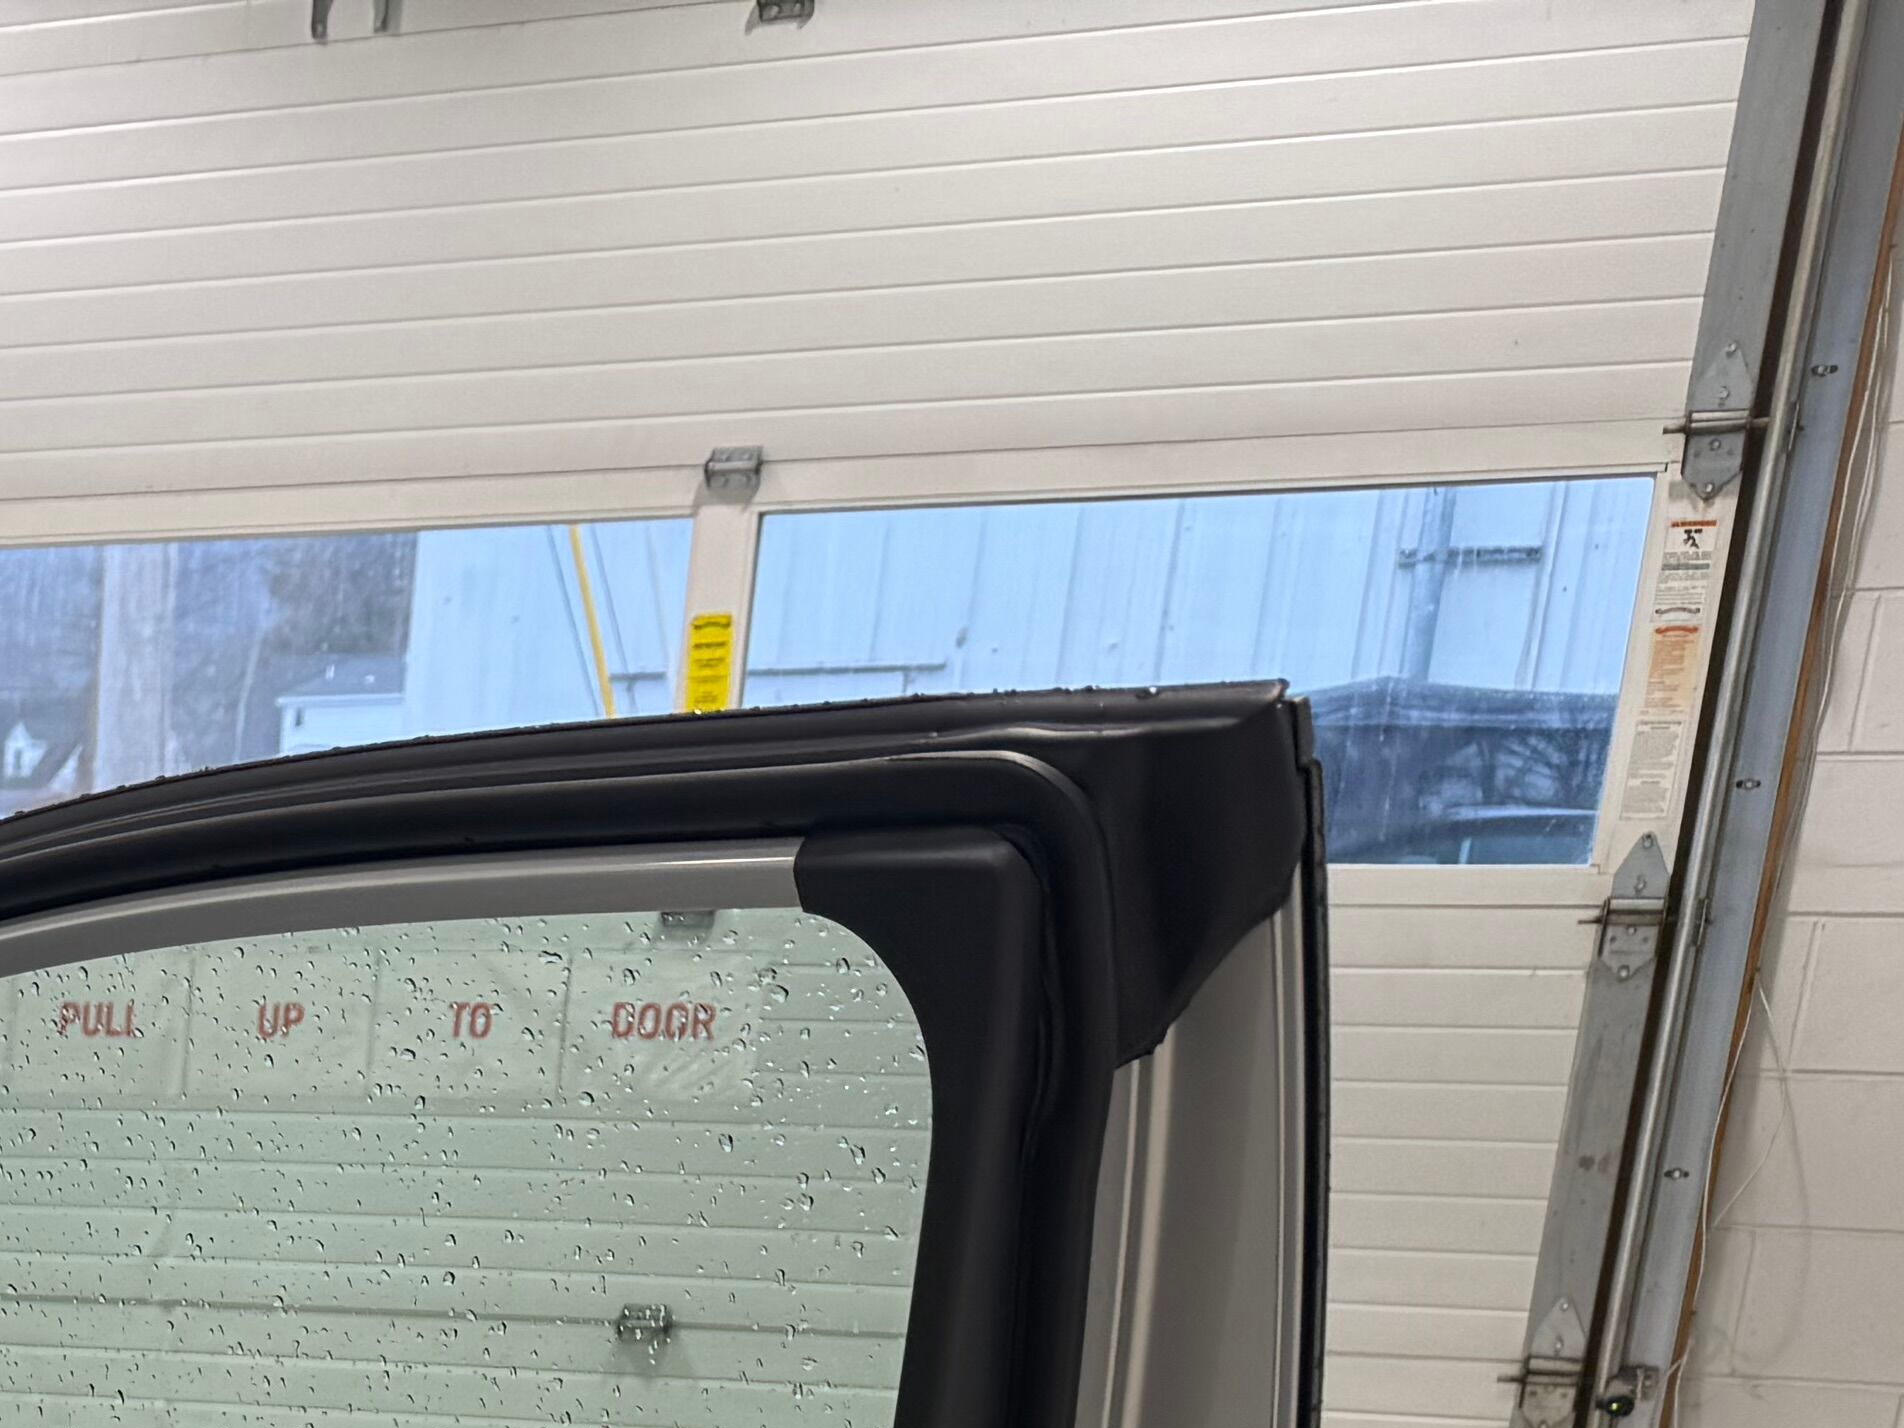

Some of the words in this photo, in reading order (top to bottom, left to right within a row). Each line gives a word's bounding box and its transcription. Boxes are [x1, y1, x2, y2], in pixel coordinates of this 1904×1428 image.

[58, 1001, 137, 1038] PULL
[257, 1001, 305, 1040] UP
[450, 1002, 494, 1040] TO
[612, 1001, 717, 1041] DOOR
